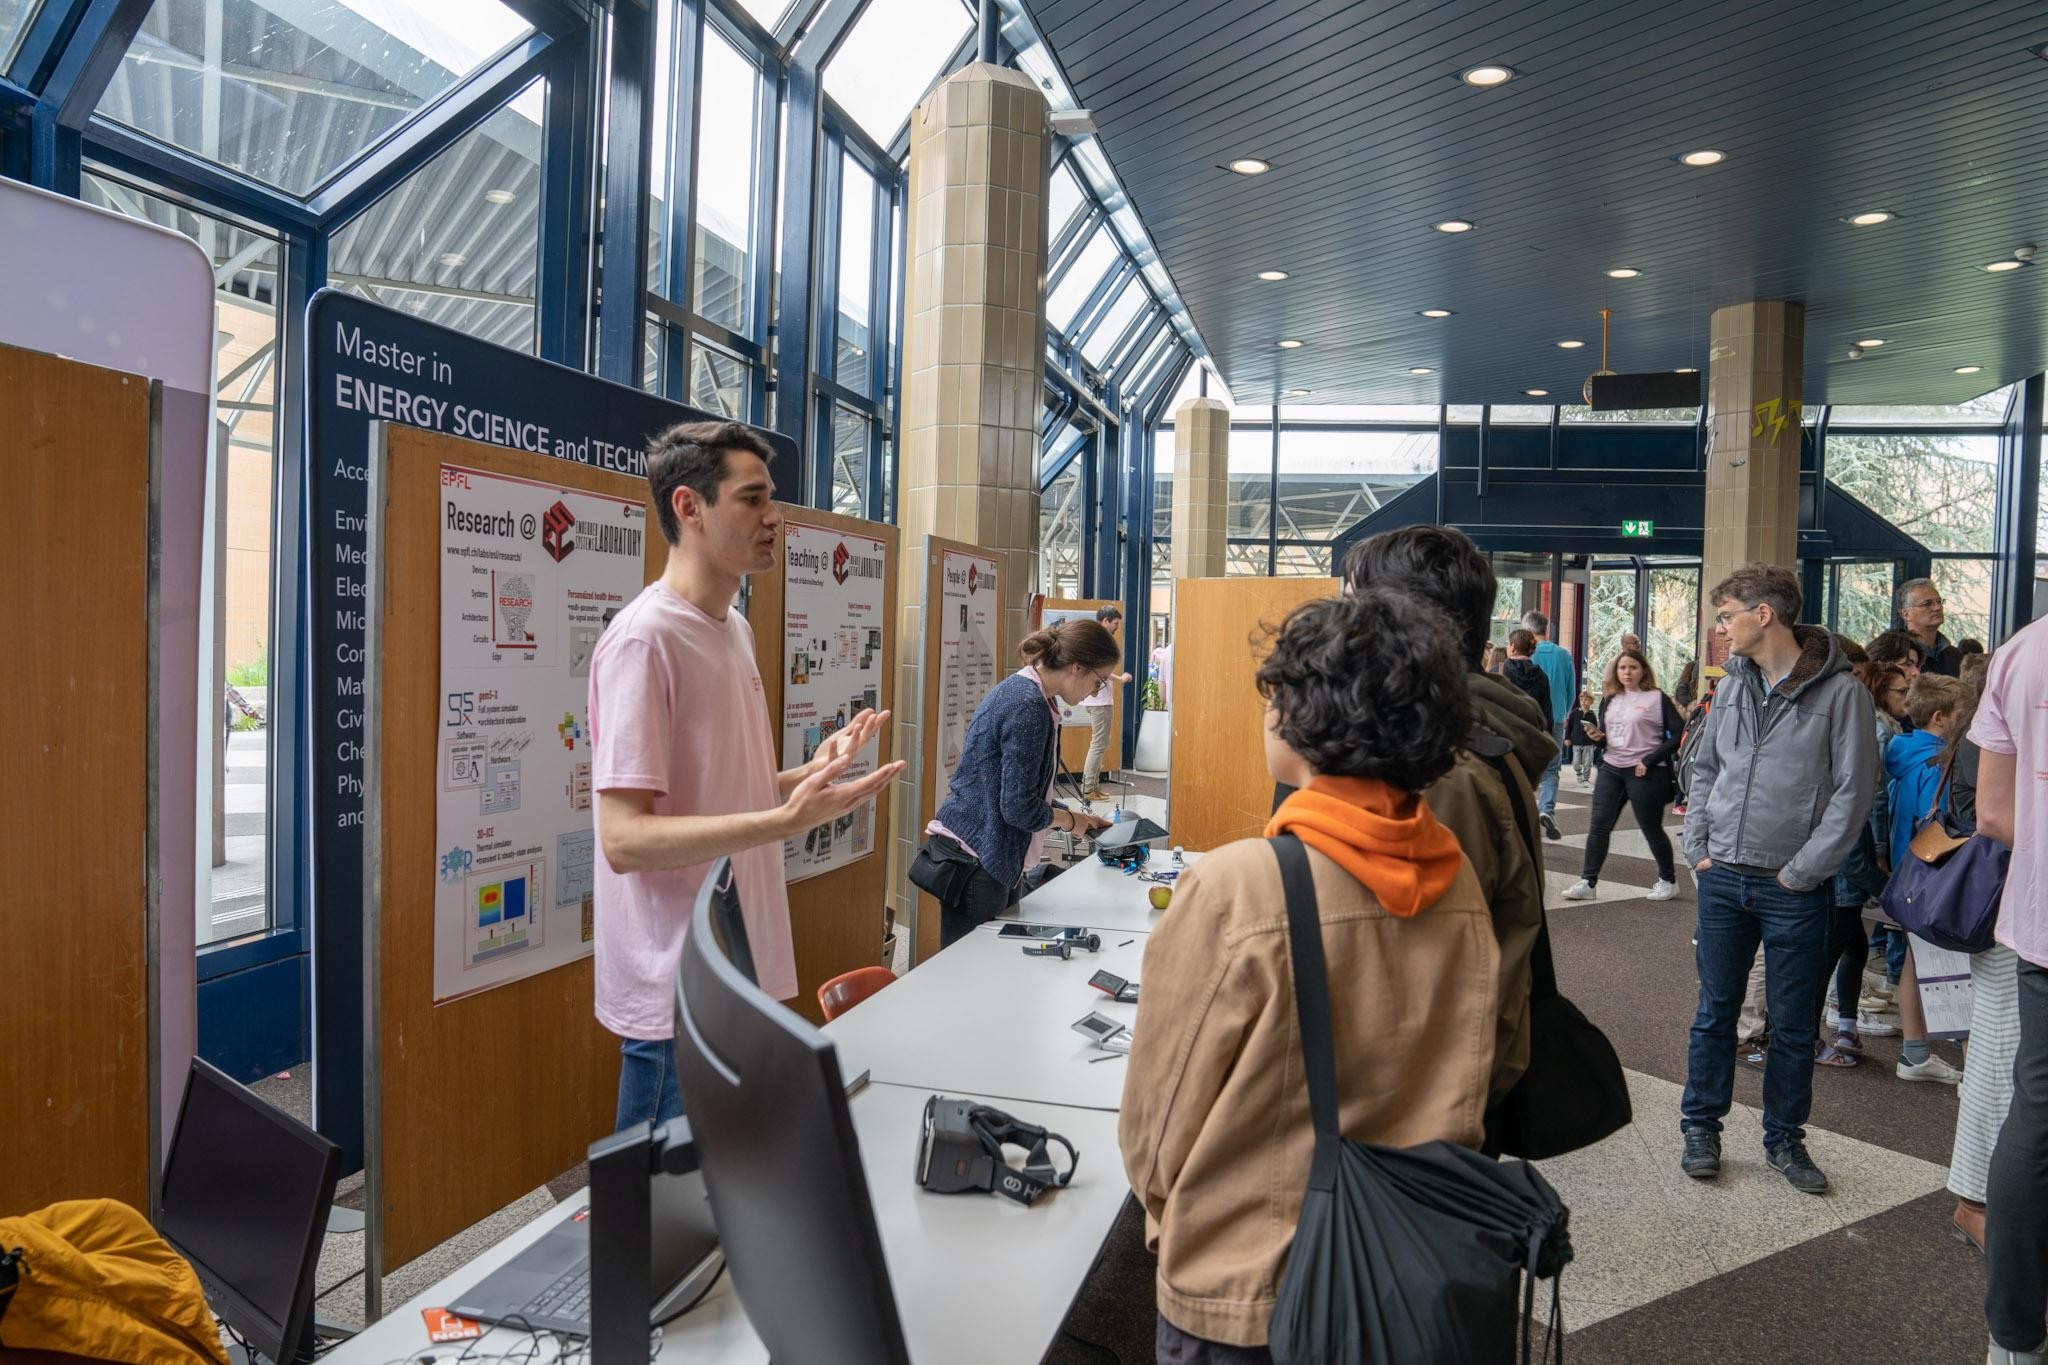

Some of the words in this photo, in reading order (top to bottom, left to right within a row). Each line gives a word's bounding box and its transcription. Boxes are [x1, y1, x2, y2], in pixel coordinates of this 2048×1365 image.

[336, 321, 426, 377] Master
[433, 352, 453, 385] in
[336, 373, 449, 430] ENERGY
[453, 405, 550, 455] SCIENCE
[555, 436, 589, 464] and
[593, 439, 649, 475] TECHN
[441, 471, 472, 490] EPFL
[447, 501, 515, 538] Research
[520, 513, 536, 540] @
[785, 526, 801, 538] EPFL
[594, 523, 642, 558] LABORATORY
[787, 546, 819, 574] Teaching
[821, 551, 829, 570] @
[946, 567, 960, 588] People
[499, 597, 532, 608] RESEARCH
